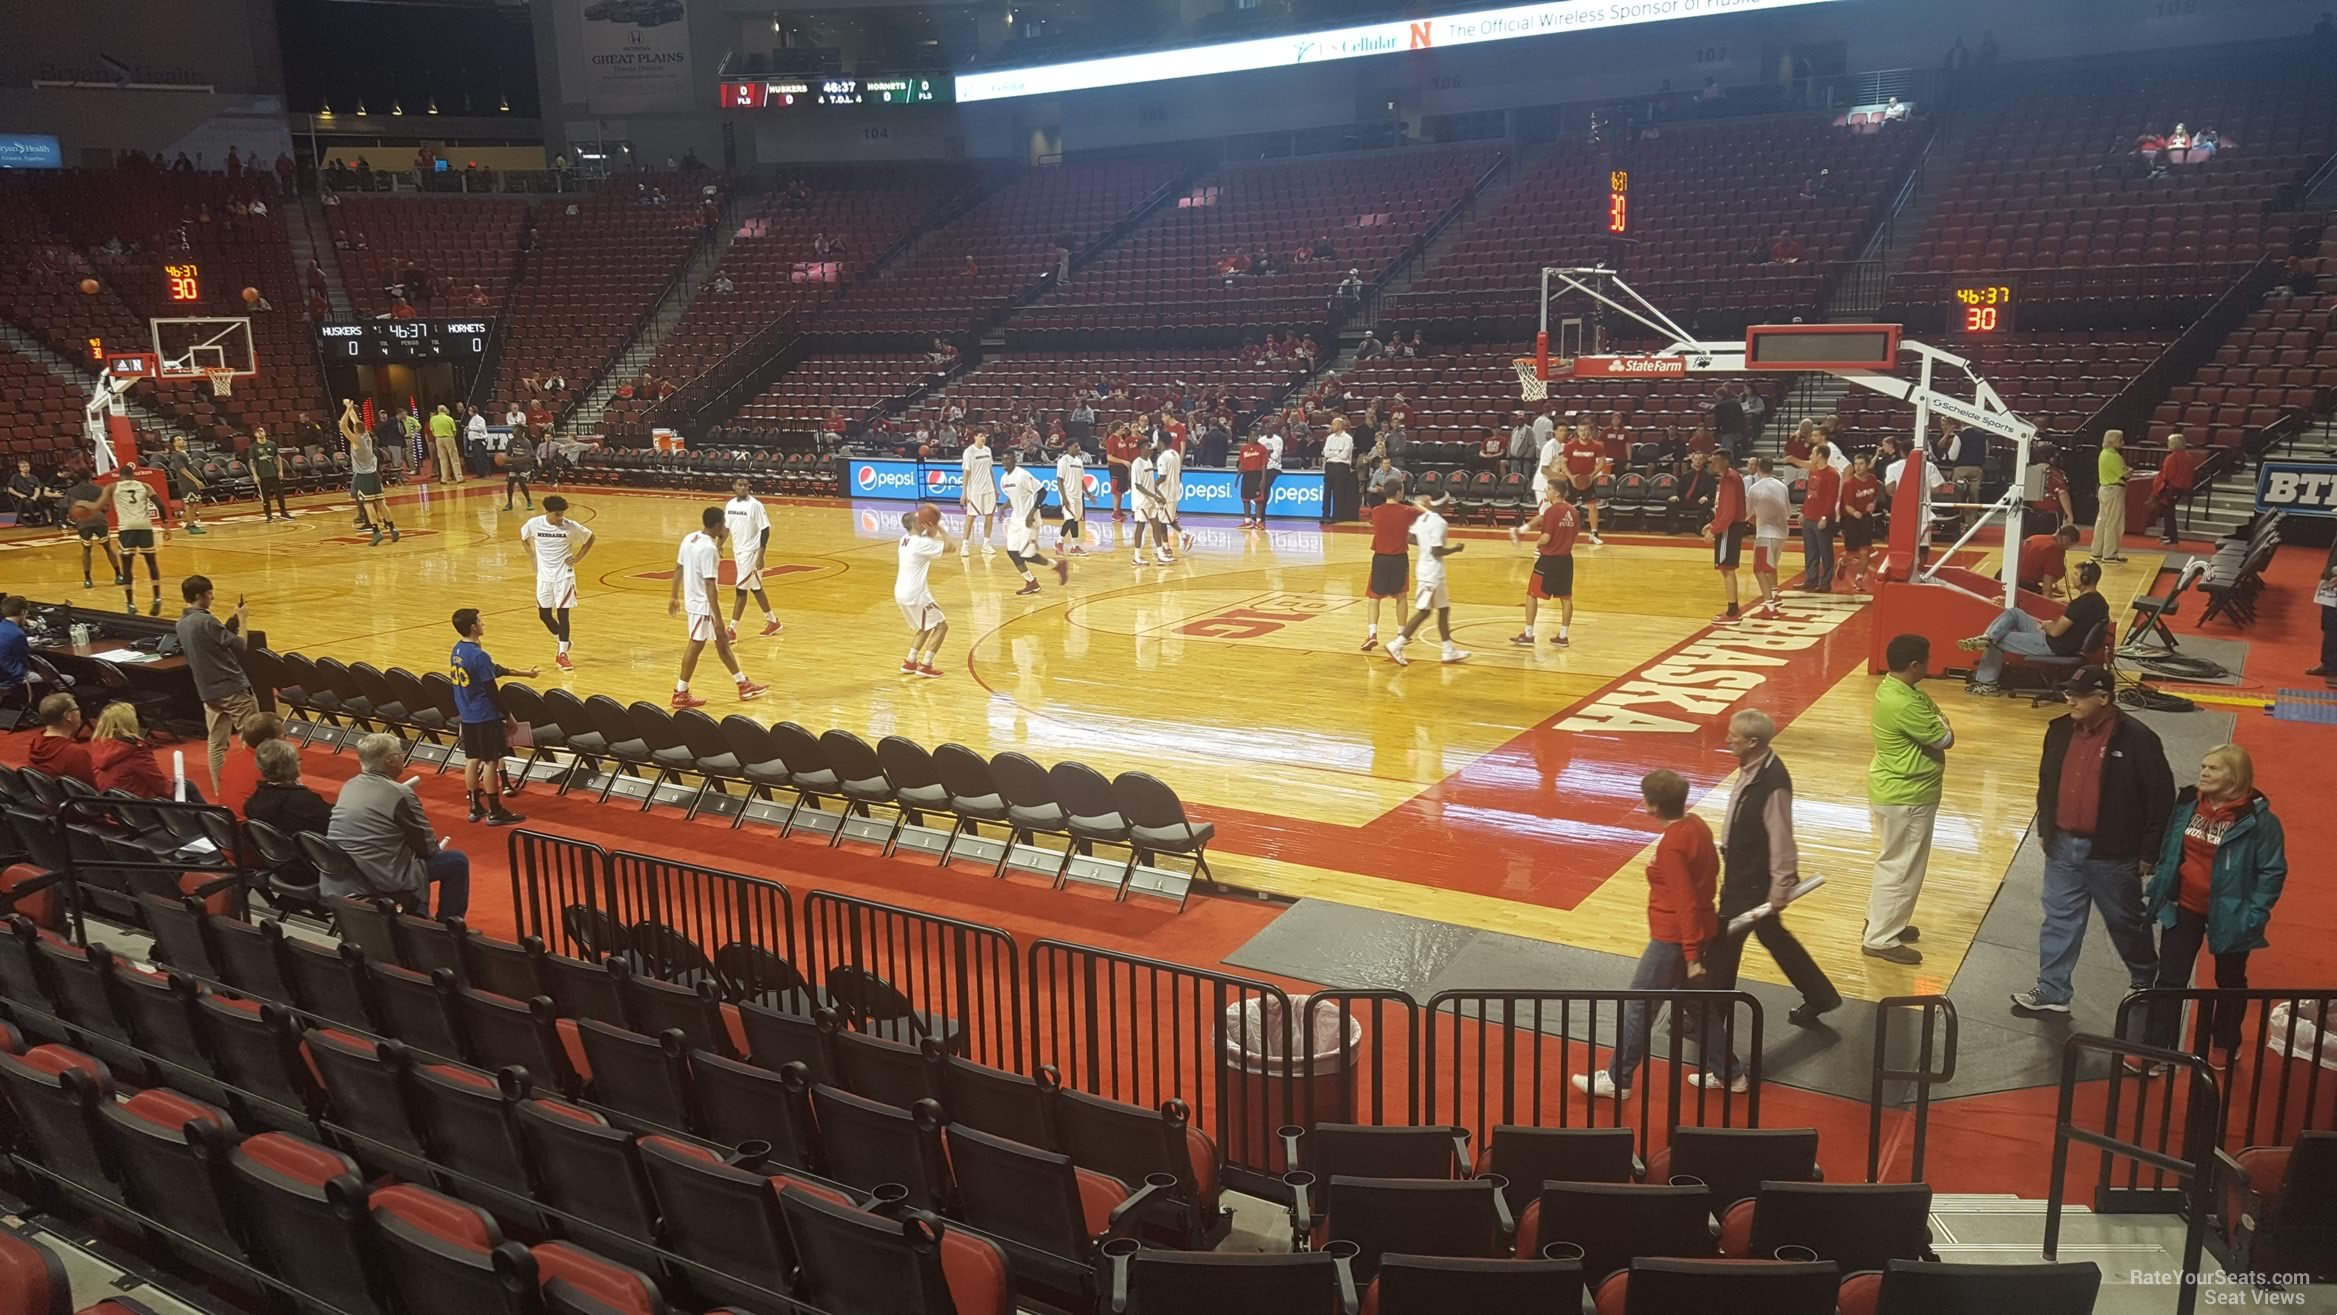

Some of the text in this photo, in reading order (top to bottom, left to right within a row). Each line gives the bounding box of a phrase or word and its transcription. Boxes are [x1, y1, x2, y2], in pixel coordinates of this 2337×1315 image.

[1342, 36, 1398, 53] Cellular
[1409, 20, 1433, 49] N
[1448, 24, 1476, 38] The
[1480, 16, 1534, 35] Official
[1539, 8, 1605, 28] Wireless
[1610, 0, 1678, 20] Sponsor
[591, 52, 685, 65] GREAT PLAINS
[739, 86, 748, 96] 0
[769, 85, 808, 94] HUSKERS
[823, 81, 857, 93] 46:37
[867, 82, 907, 91] HORNETS
[921, 80, 930, 91] 0
[785, 94, 794, 105] 0
[818, 95, 825, 104] 4
[855, 95, 863, 104] 4
[883, 91, 892, 102] 0
[863, 128, 889, 139] 104
[1611, 194, 1626, 232] 30
[164, 264, 198, 277] 46:37
[171, 278, 197, 299] 30
[1957, 287, 2010, 304] 46:37
[1967, 308, 1996, 330] 30
[322, 326, 362, 337] HUSKERS
[389, 323, 428, 338] 46:37
[447, 323, 486, 335] HORNETS
[348, 340, 358, 355] 0
[433, 346, 440, 354] 4
[472, 337, 482, 352] 0
[1982, 416, 2014, 433] Sports
[877, 471, 915, 496] pepsi
[127, 489, 138, 504] 3
[1184, 482, 1231, 505] pepsi
[1275, 485, 1324, 510] pepsi
